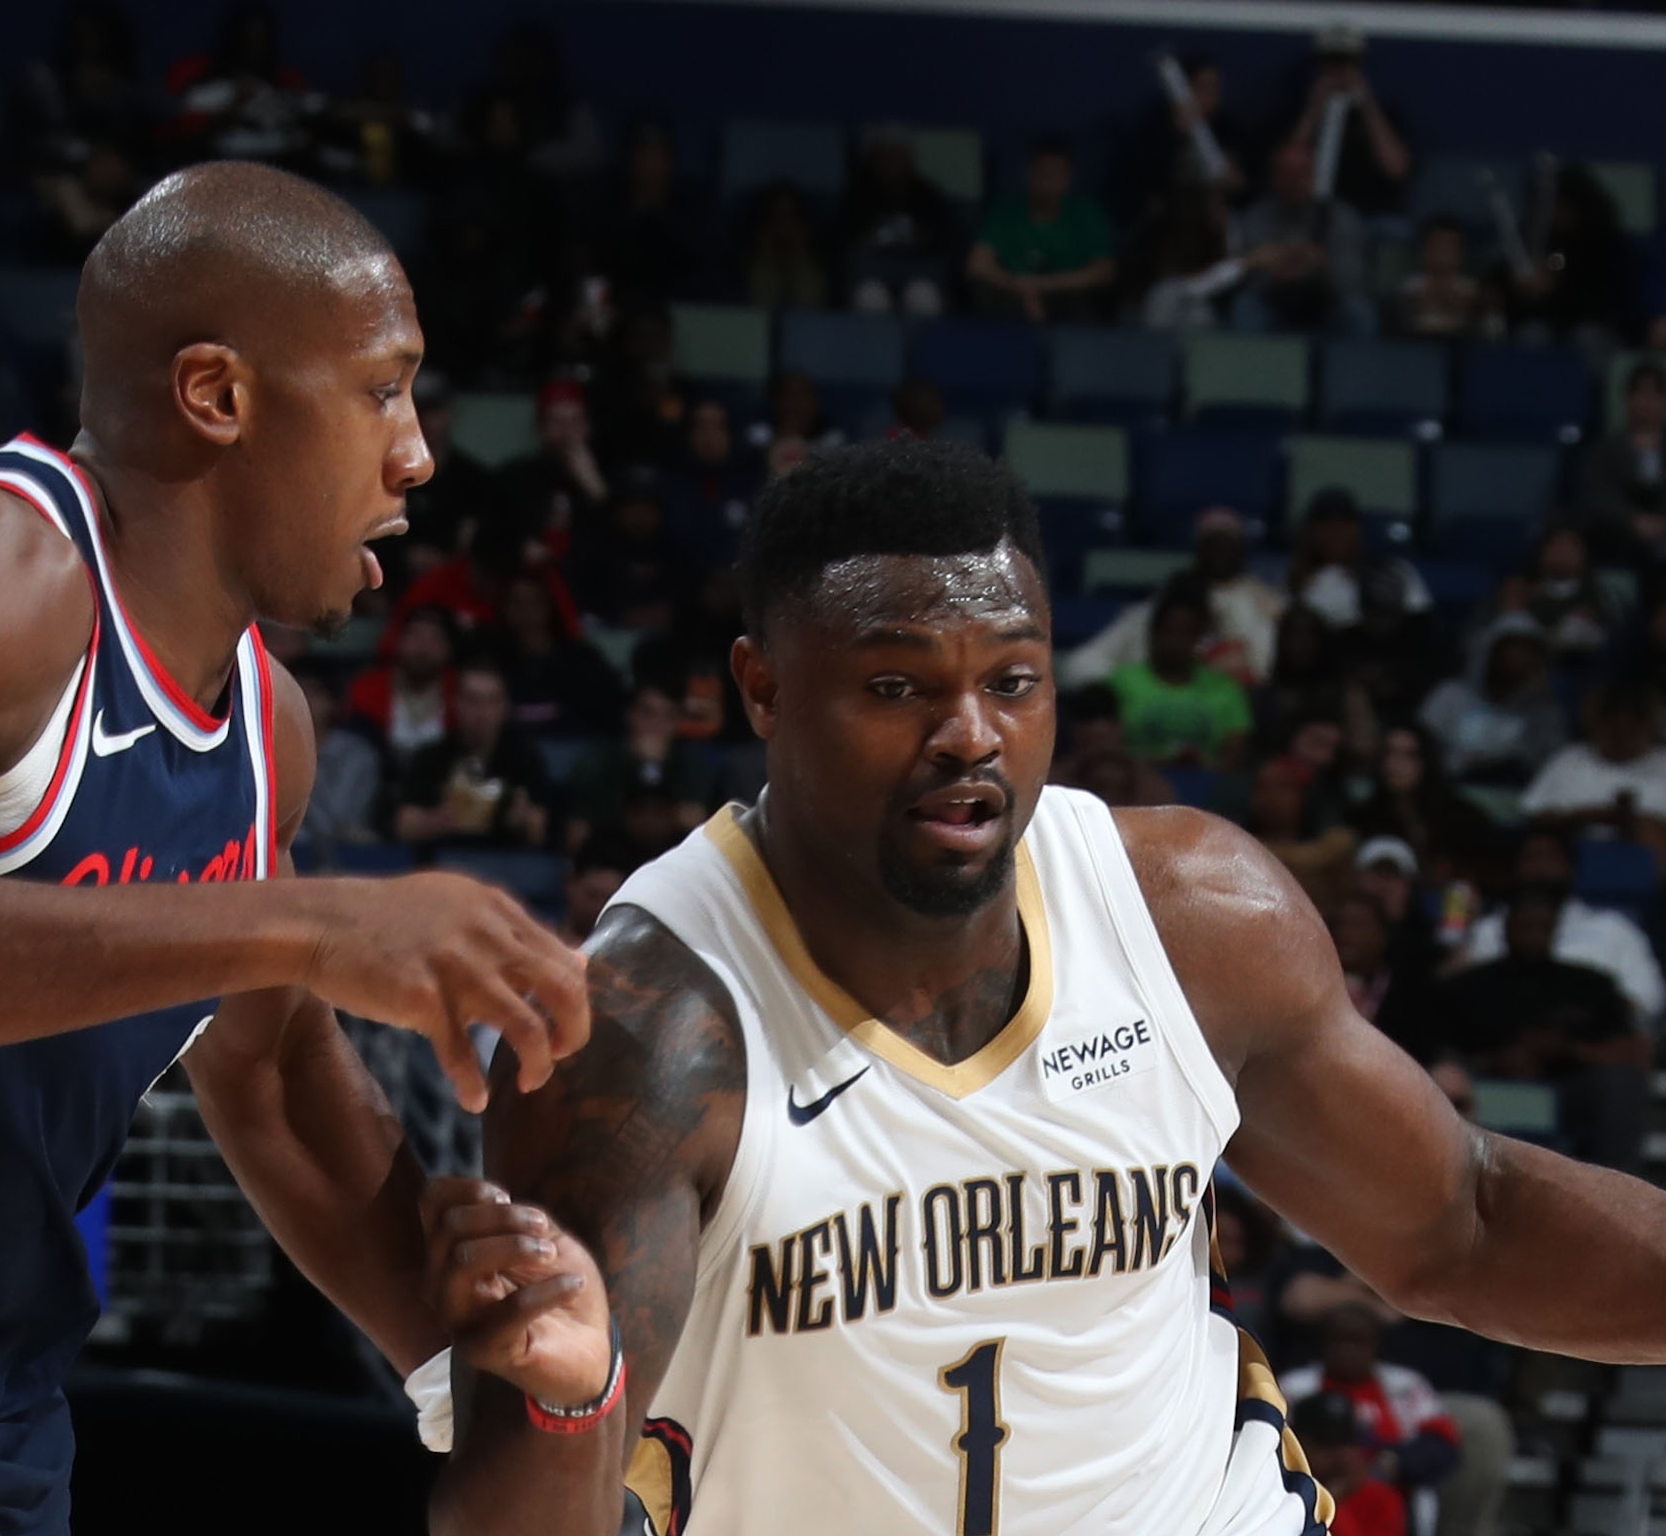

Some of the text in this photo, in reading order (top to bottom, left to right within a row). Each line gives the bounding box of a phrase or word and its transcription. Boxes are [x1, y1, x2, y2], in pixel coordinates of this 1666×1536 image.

[1041, 1019, 1151, 1079] NEWAGE
[1071, 1059, 1131, 1091] GRILLS
[746, 1160, 1200, 1338] NEW ORLEANS
